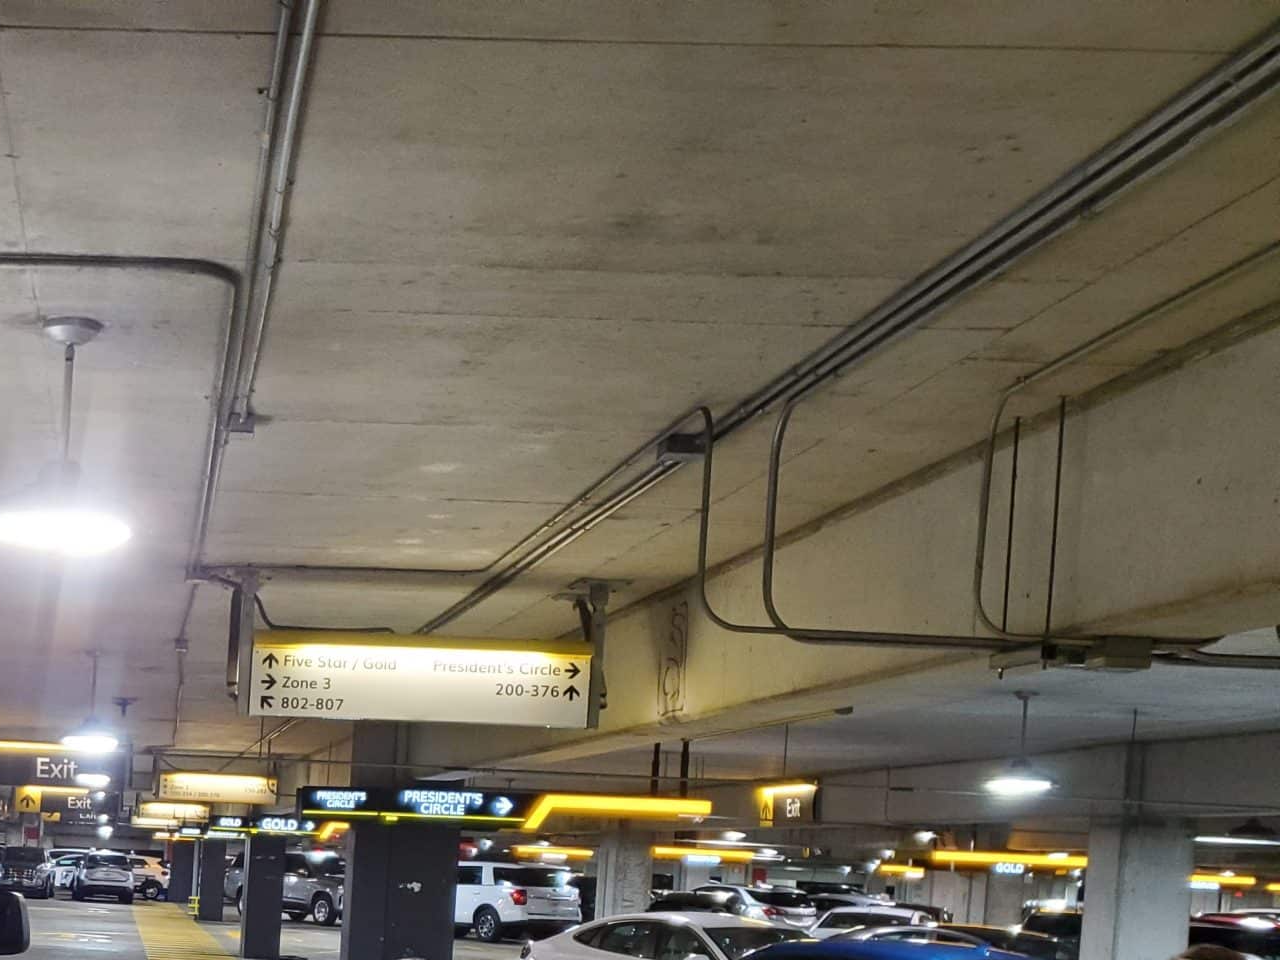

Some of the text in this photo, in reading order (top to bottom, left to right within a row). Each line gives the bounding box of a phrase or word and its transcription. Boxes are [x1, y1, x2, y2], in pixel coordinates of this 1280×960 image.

[283, 655, 315, 669] Five
[318, 656, 348, 670] Star
[363, 657, 397, 671] Gold
[433, 659, 561, 677] President's Circle
[281, 677, 332, 690] Zone 3
[495, 683, 560, 698] 200-376
[281, 697, 344, 711] 802-807
[36, 757, 78, 780] Exit
[67, 796, 91, 810] Exit
[326, 800, 355, 809] CIRCLE
[404, 790, 483, 805] PRESIDENT'S
[420, 803, 465, 815] CIRCLE
[786, 799, 801, 818] Exit
[262, 818, 298, 830] GOLD
[995, 862, 1025, 874] GOLD
